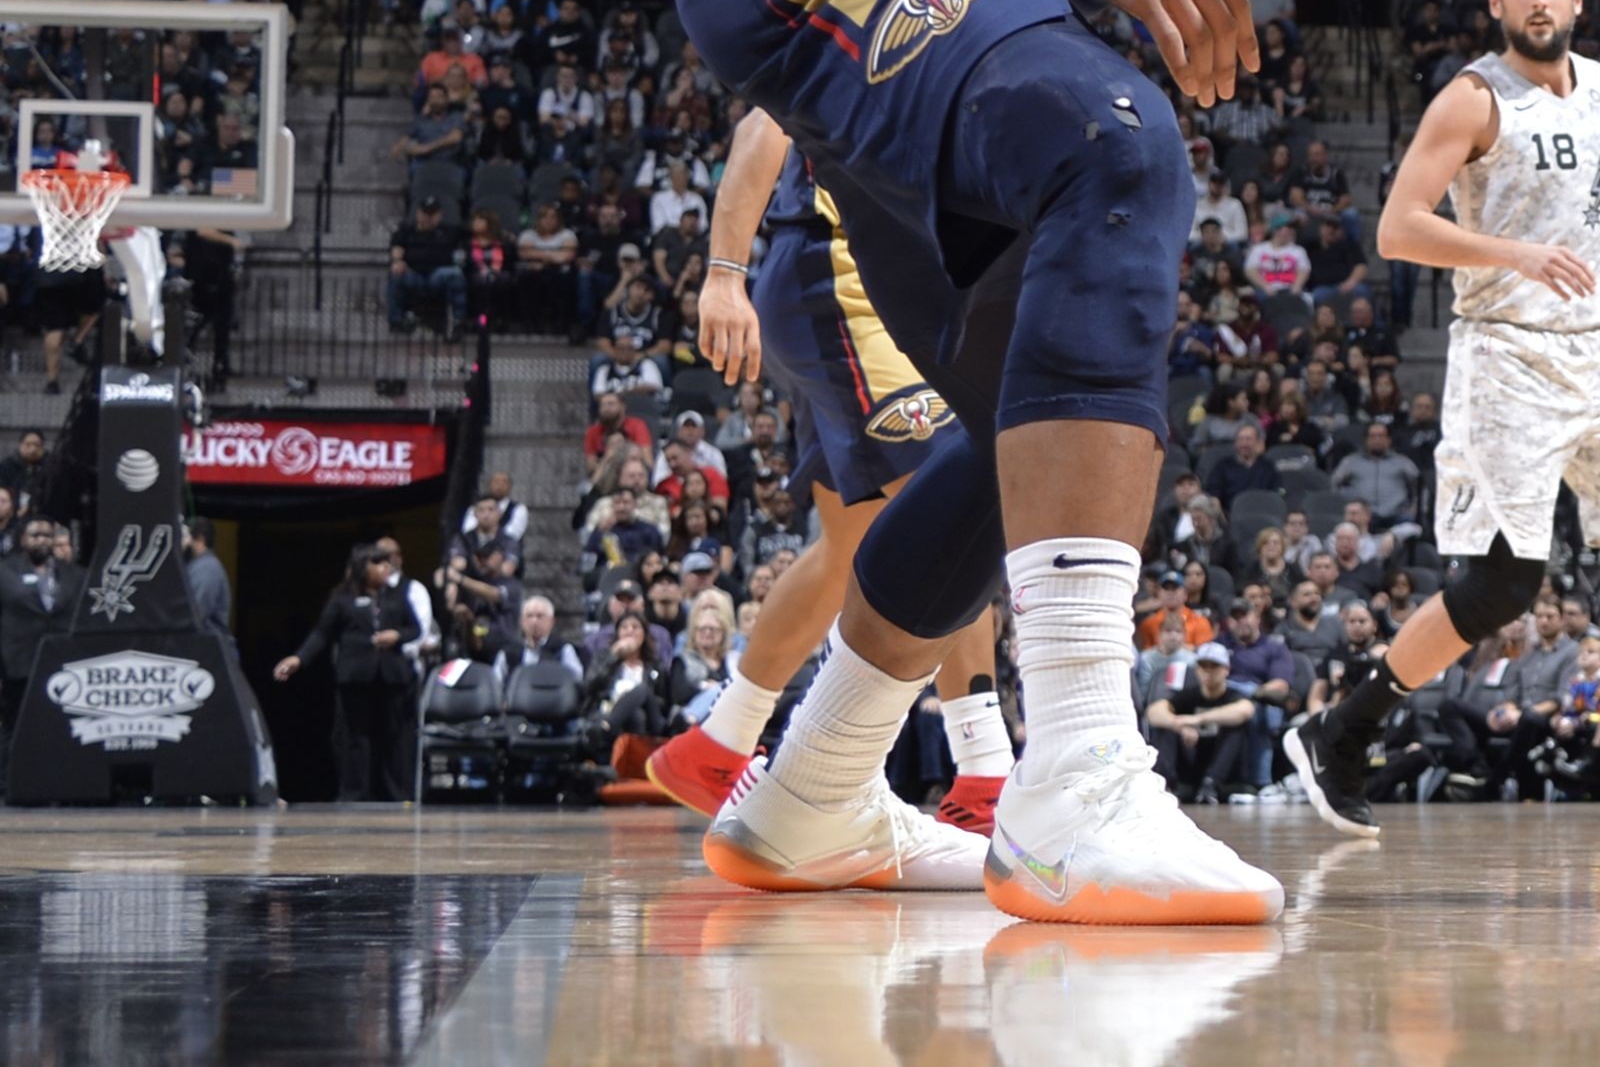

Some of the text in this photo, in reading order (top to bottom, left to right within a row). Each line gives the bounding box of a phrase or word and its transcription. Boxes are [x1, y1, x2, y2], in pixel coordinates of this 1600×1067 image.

[1531, 134, 1578, 171] 18
[319, 437, 414, 470] EAGLE
[87, 666, 177, 685] BRAKE
[86, 688, 176, 707] CHECK
